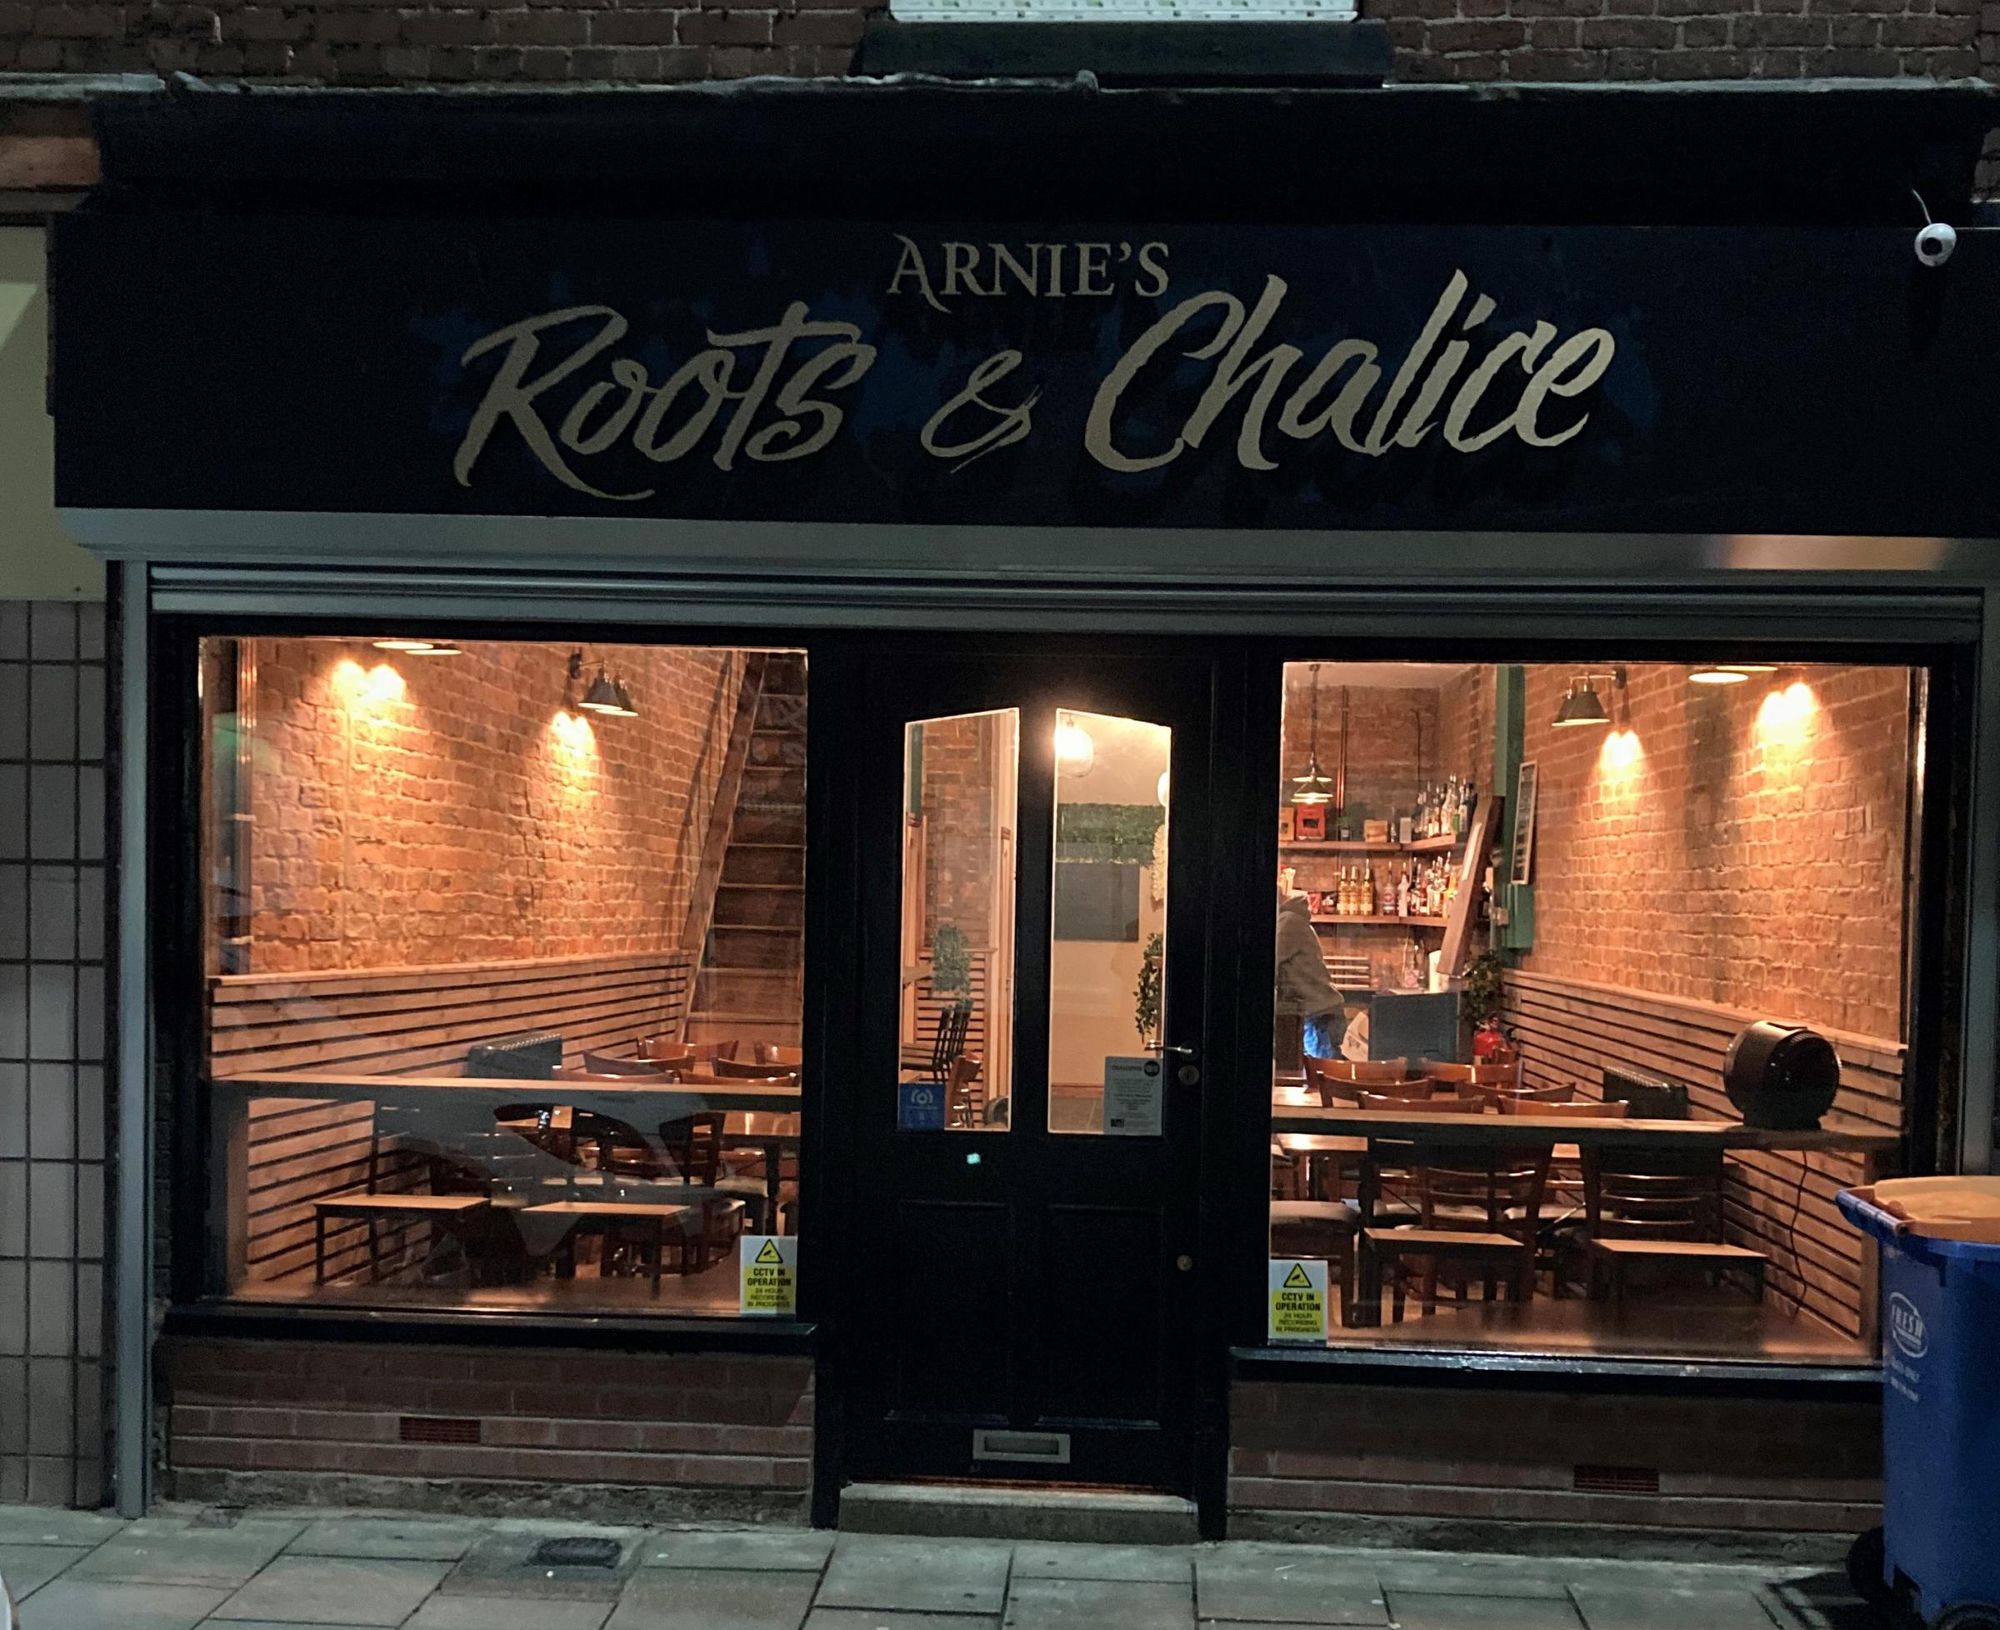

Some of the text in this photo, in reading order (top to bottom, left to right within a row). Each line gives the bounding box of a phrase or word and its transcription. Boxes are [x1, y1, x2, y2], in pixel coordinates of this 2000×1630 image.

[886, 233, 1170, 313] ARNIE'S
[453, 268, 1615, 500] Roots & Chalice
[753, 1268, 786, 1276] CCTV IN
[747, 1277, 791, 1286] OPERATION
[1281, 1292, 1315, 1301] CCTV IN
[1276, 1302, 1320, 1311] OPERATION
[1891, 1304, 1923, 1337] FRESH
